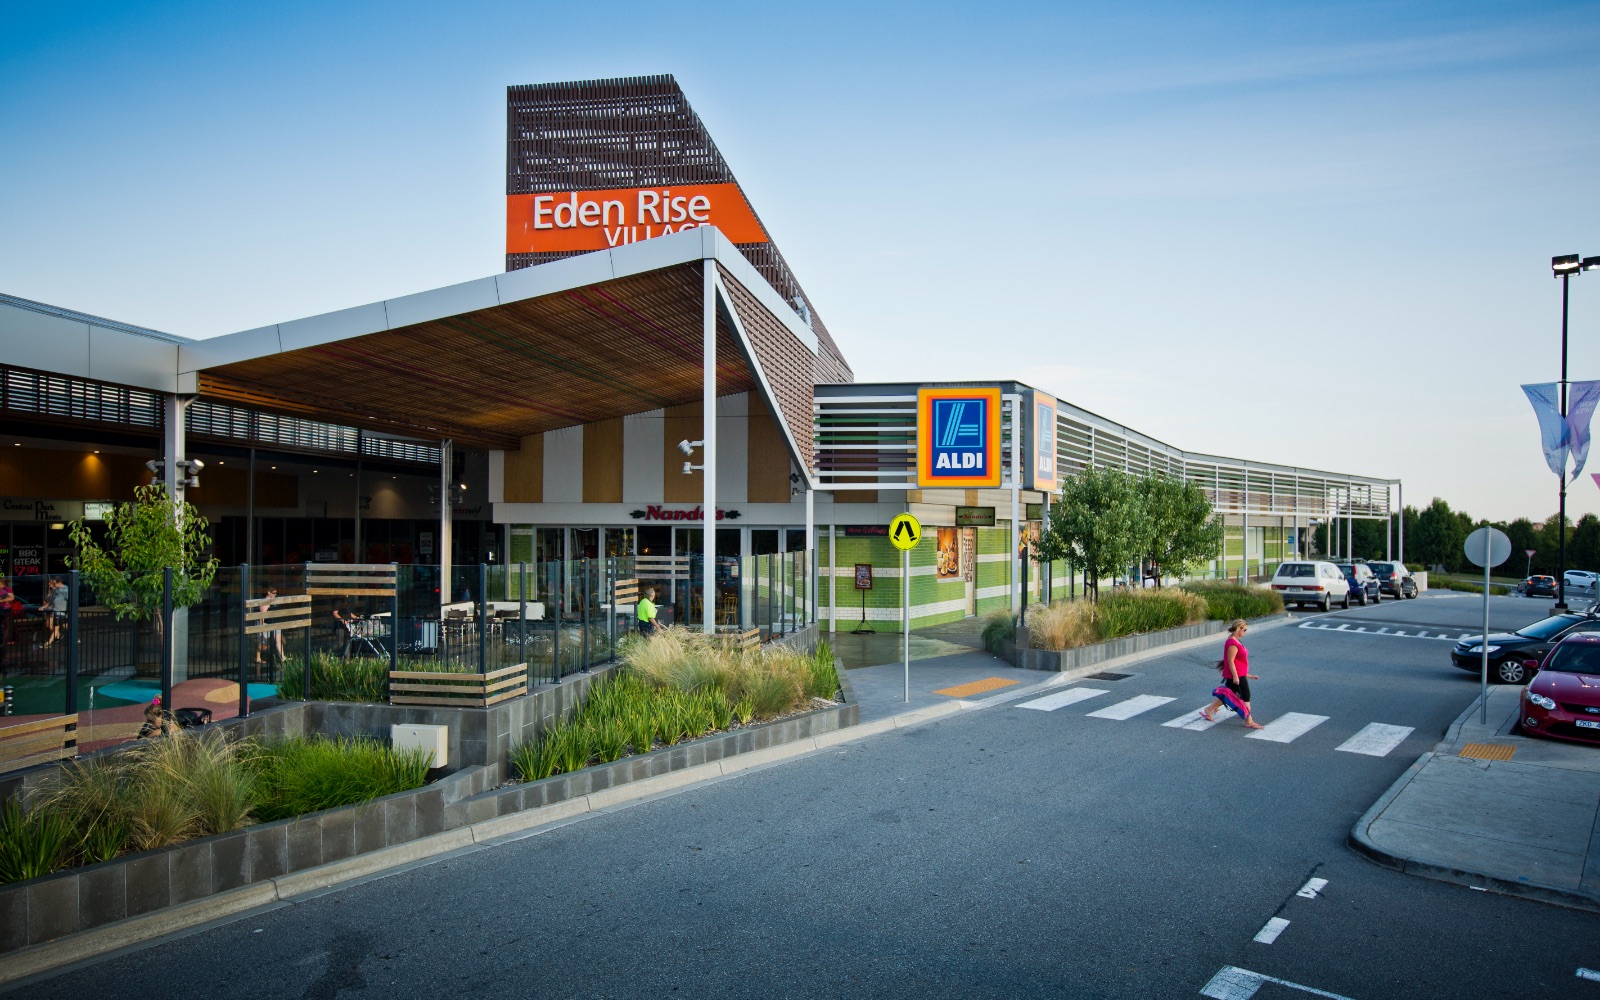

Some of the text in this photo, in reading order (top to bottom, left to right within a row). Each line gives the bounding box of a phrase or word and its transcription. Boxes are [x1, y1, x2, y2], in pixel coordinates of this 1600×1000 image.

[534, 190, 711, 229] Eden Rise
[604, 223, 711, 247] VILLA
[936, 452, 983, 469] ALDI
[1039, 455, 1053, 473] ALDI
[3, 500, 55, 511] Central Park
[645, 505, 725, 521] Nands
[13, 557, 42, 566] STEAK
[18, 549, 38, 558] BBQ
